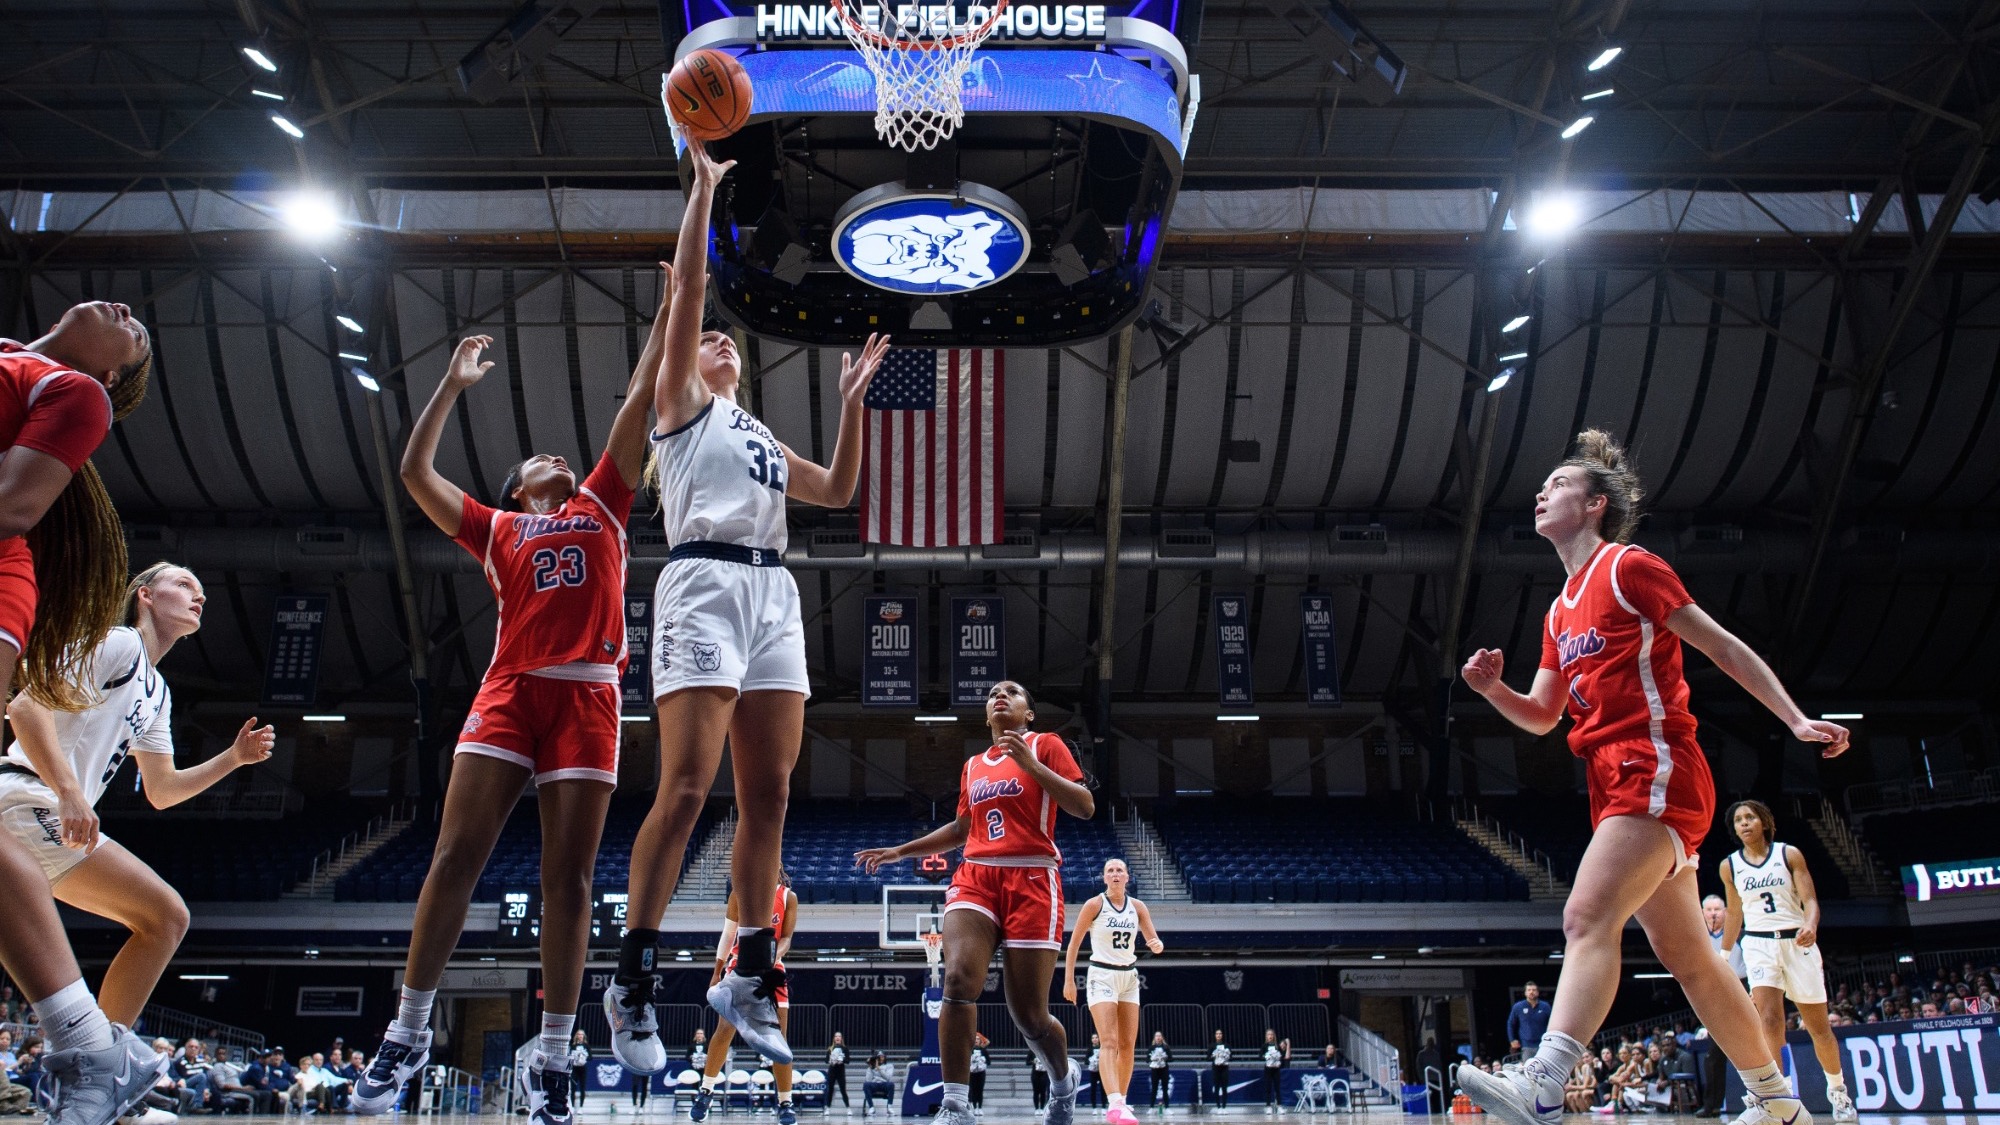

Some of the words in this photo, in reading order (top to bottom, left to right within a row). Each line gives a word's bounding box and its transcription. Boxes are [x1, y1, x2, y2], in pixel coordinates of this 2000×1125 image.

[757, 4, 880, 37] HINKLE
[896, 4, 1107, 37] FIELDHOUSE
[694, 55, 725, 100] ELITE
[746, 439, 785, 494] 32
[513, 514, 604, 552] Titans
[751, 549, 763, 565] B
[532, 545, 586, 592] 23
[277, 611, 323, 623] CONFERENCE
[1305, 611, 1330, 625] NCAA
[872, 625, 910, 650] 2010
[961, 625, 995, 650] 2011
[1220, 626, 1245, 641] 1929
[884, 666, 898, 675] 33-5
[1228, 664, 1242, 673] 17-2
[1569, 673, 1591, 709] 1
[985, 808, 1005, 841] 2
[922, 853, 948, 871] 25
[1743, 872, 1786, 892] Butler
[1936, 866, 2000, 890] BUTL
[508, 903, 527, 918] 20
[614, 904, 628, 918] 12
[1760, 892, 1777, 914] 3
[1106, 917, 1136, 929] Butler
[512, 926, 518, 937] 1
[531, 926, 539, 937] 4
[592, 926, 600, 937] 4
[1112, 931, 1132, 950] 23
[590, 974, 665, 989] BUR
[834, 974, 908, 990] BUTLER
[1913, 1020, 1935, 1030] HINKLE
[1935, 1018, 1974, 1028] FIELDHOUSE
[921, 1056, 941, 1064] BUTL
[1846, 1028, 2000, 1110] BUTL
